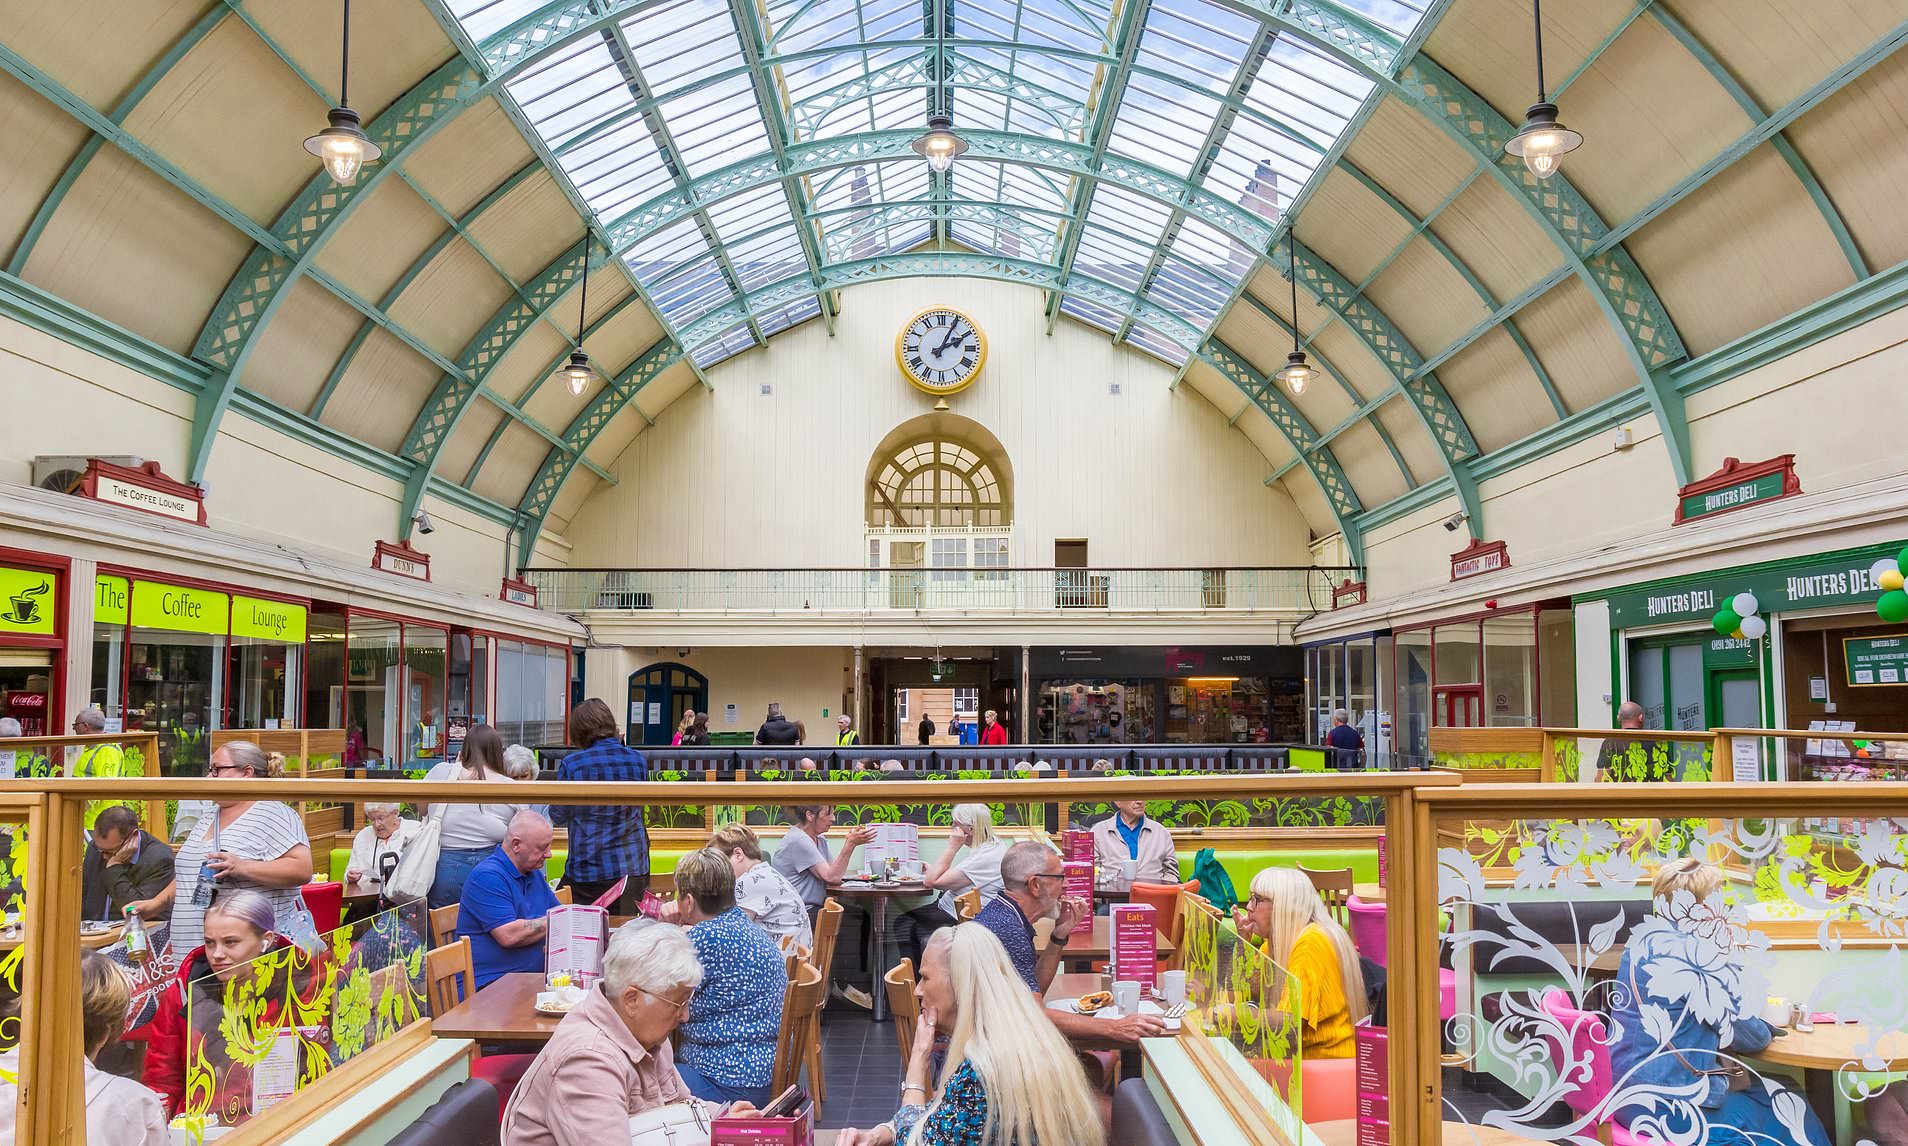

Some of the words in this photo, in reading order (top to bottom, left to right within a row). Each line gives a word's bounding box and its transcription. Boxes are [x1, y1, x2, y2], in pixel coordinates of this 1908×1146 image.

[130, 490, 157, 505] COFFEE
[158, 497, 185, 512] LOUNGE
[1705, 489, 1739, 511] HUNTERS
[1739, 484, 1757, 502] DELI
[1786, 572, 1848, 601] HUNTERS
[1848, 568, 1884, 595] DEL
[96, 582, 125, 609] The
[162, 592, 202, 618] Coffee
[252, 605, 287, 636] Lounge
[1647, 593, 1689, 617] HUNTERS
[1690, 589, 1714, 612] DELI
[1071, 868, 1084, 876] Eats
[1126, 912, 1145, 921] Eats
[127, 955, 176, 991] M&S
